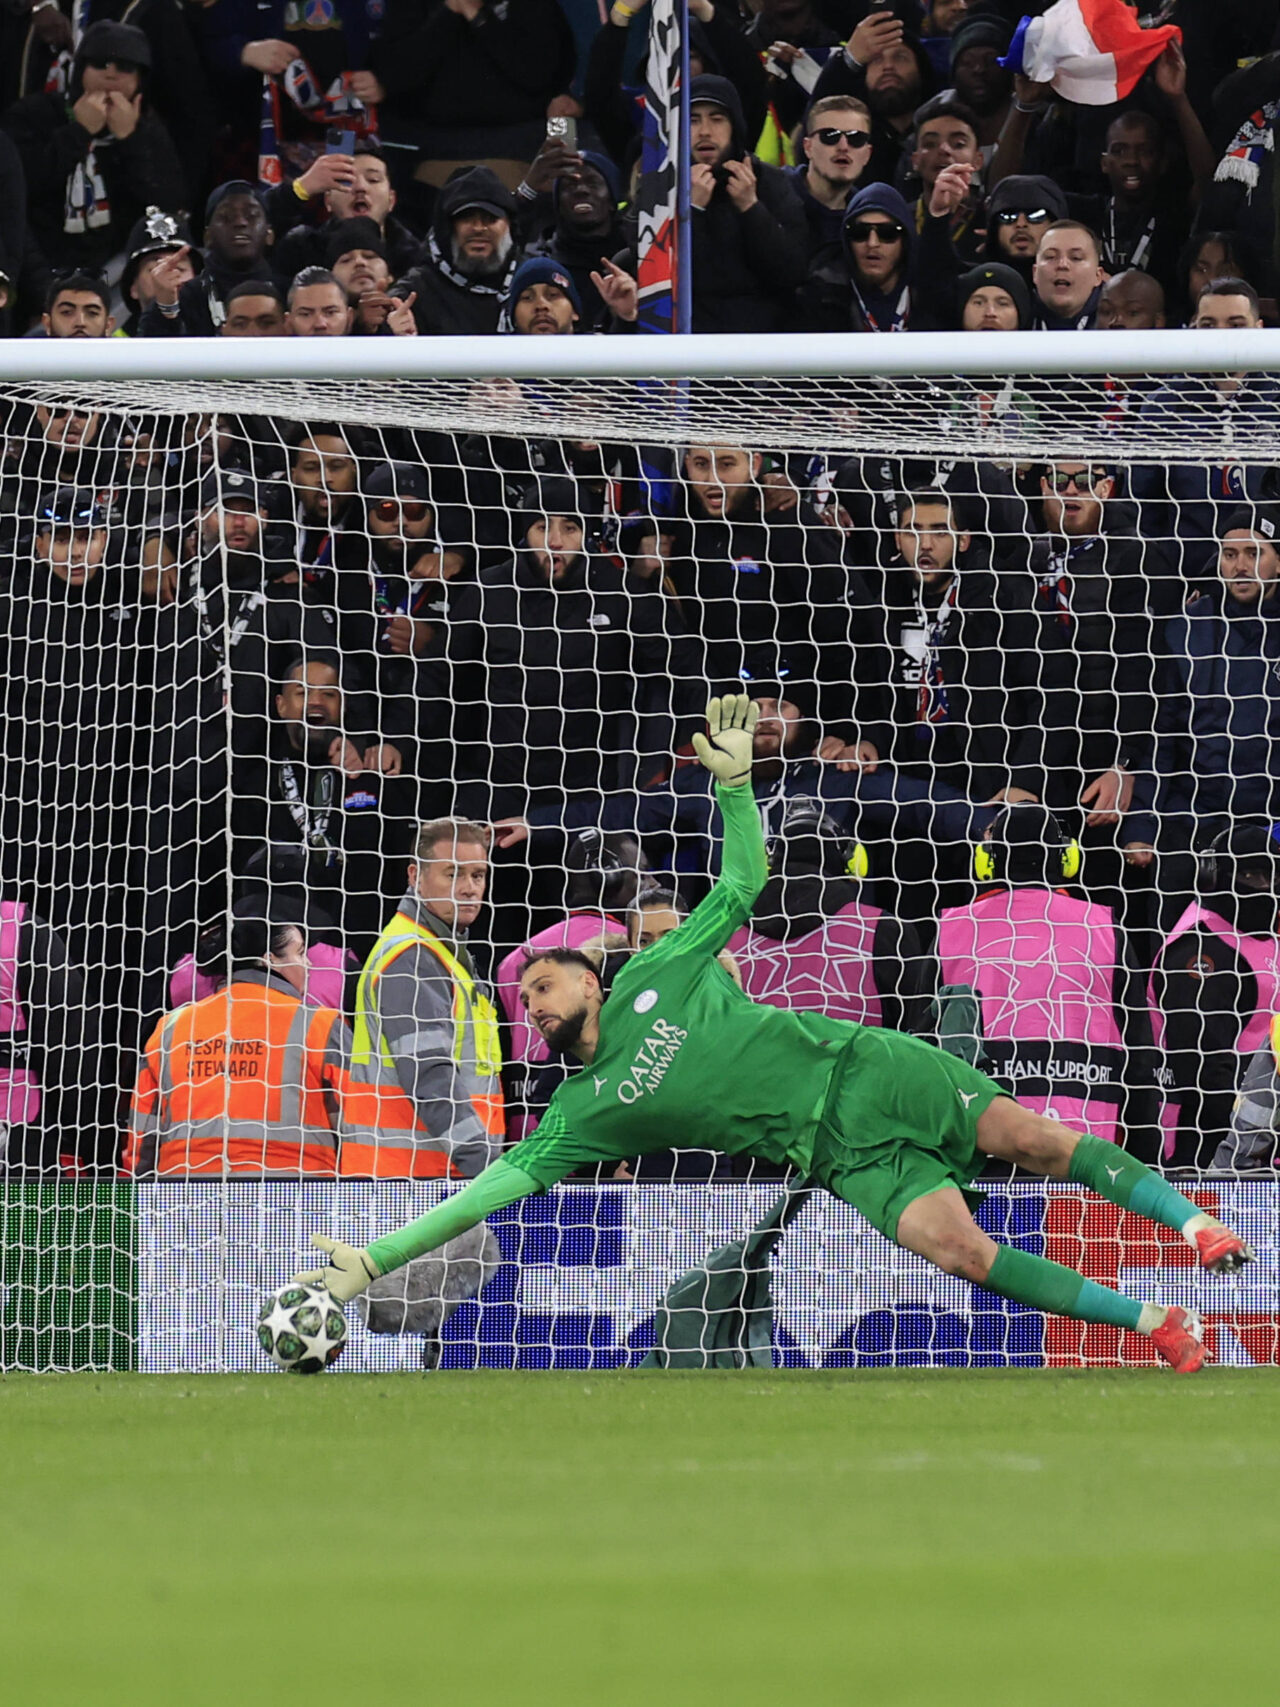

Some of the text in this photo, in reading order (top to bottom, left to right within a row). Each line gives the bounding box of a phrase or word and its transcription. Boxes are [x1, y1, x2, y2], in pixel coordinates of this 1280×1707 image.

[186, 1060, 258, 1078] STEWARD
[617, 1018, 676, 1105] QATAR
[645, 1028, 688, 1095] AIRWAYS
[1004, 1059, 1042, 1077] FAN
[1046, 1059, 1113, 1083] SUPPORT
